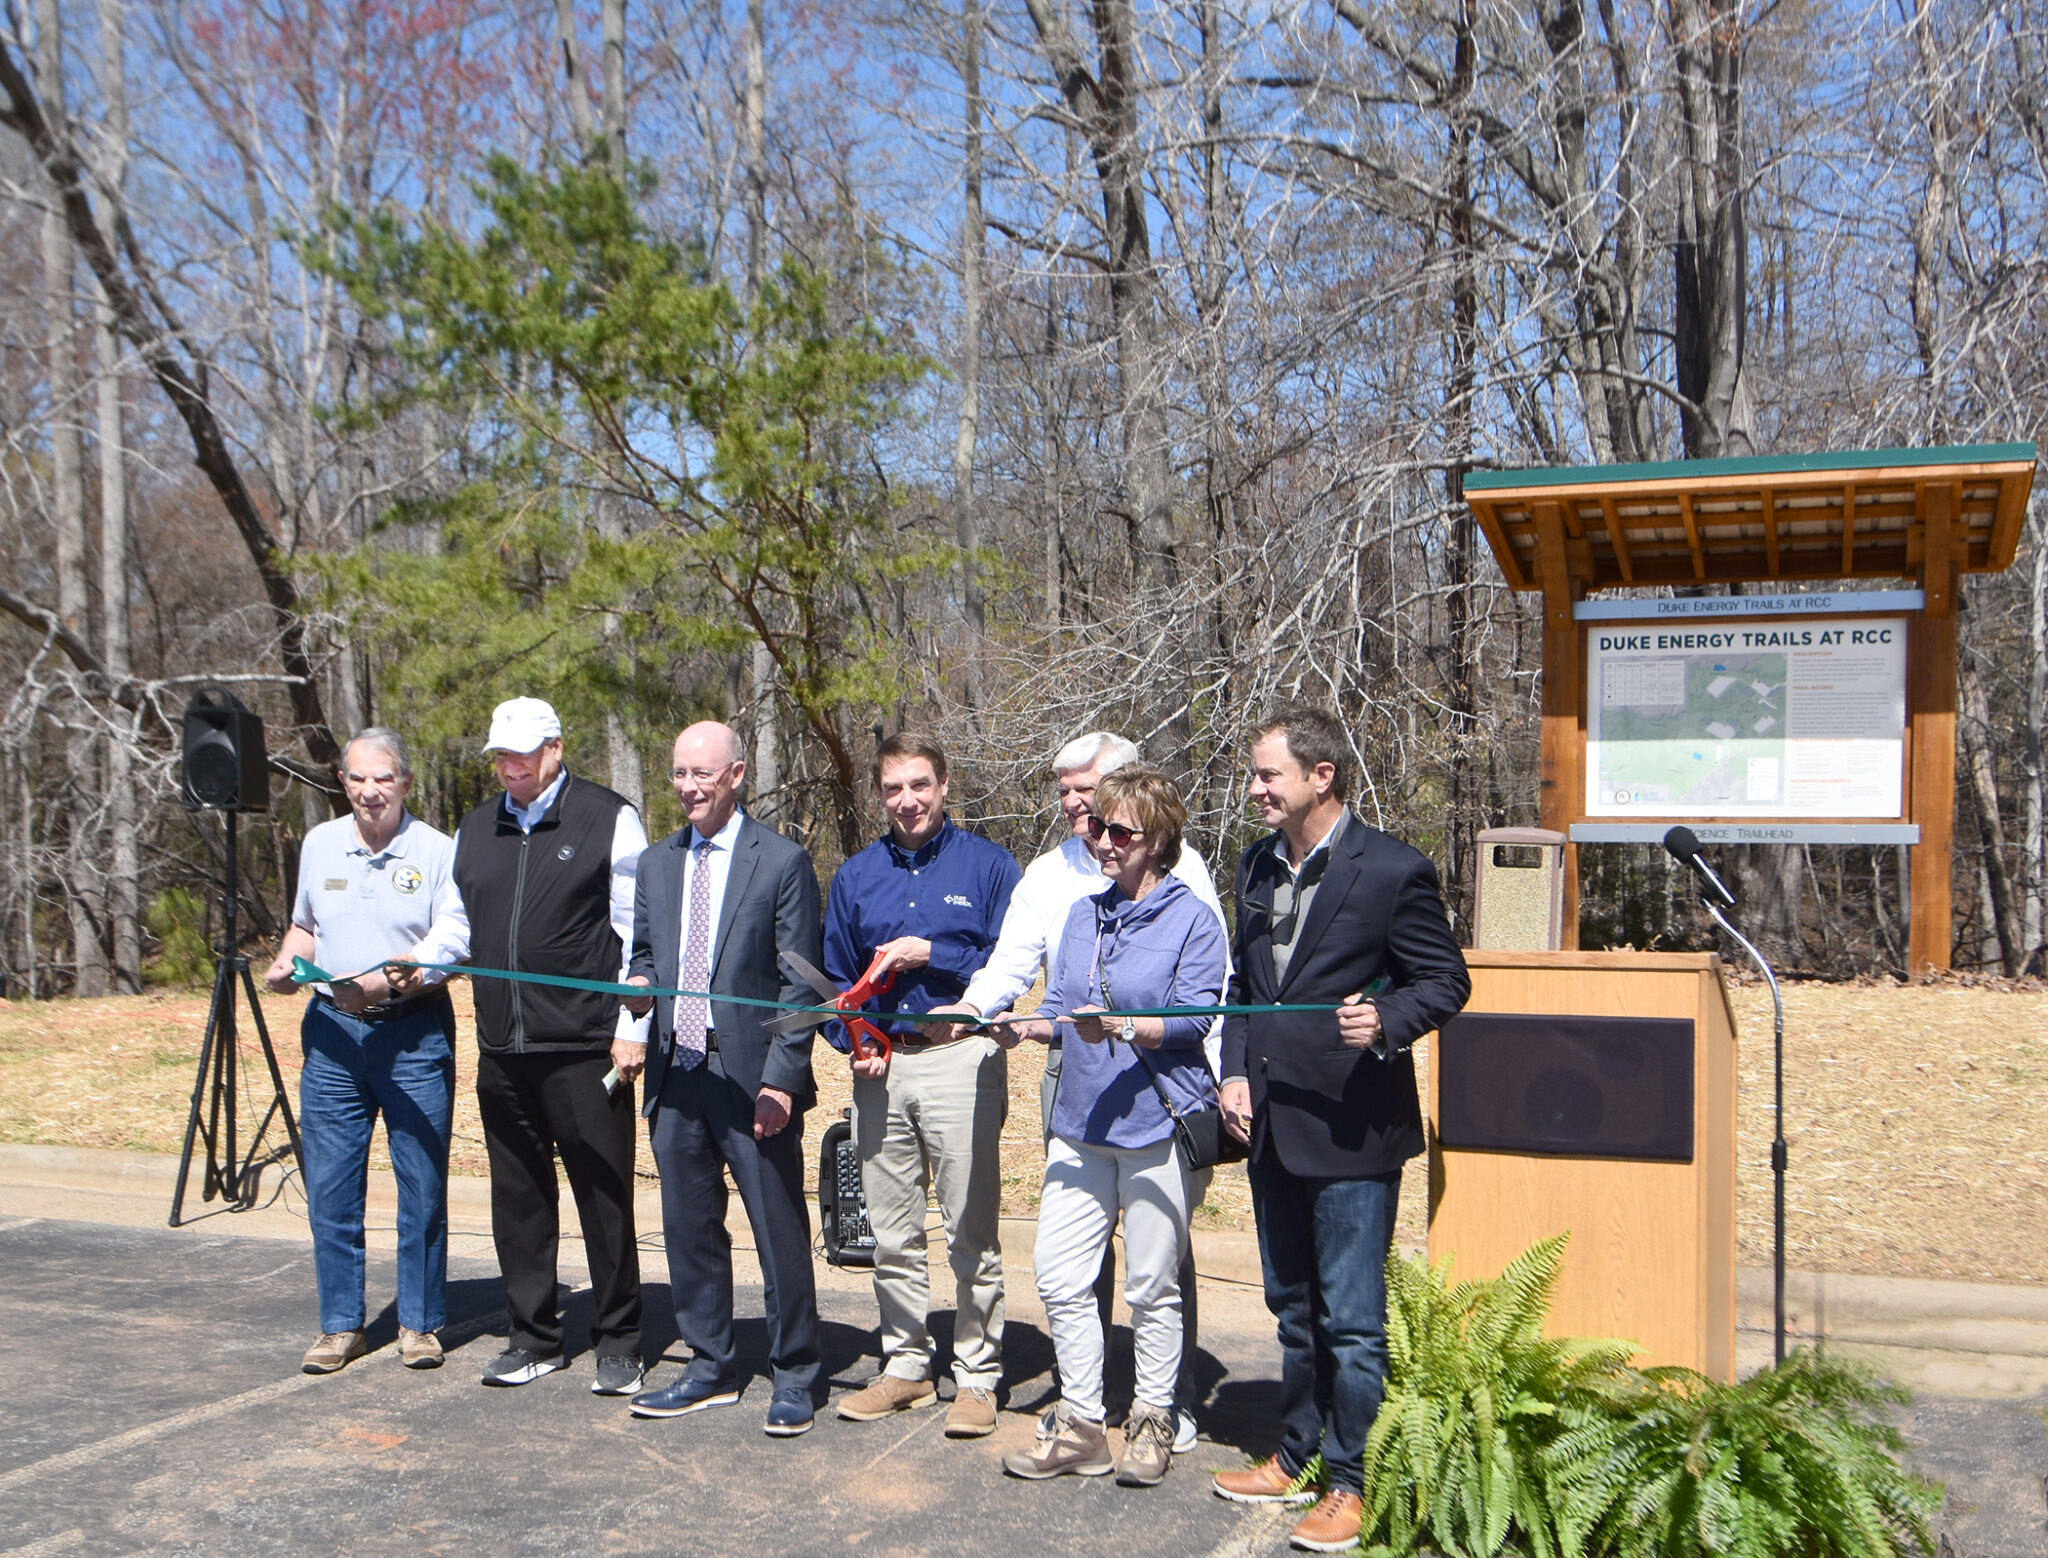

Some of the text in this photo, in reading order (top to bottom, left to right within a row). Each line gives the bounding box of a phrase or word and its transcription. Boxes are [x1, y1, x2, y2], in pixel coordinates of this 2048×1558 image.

[1658, 597, 1831, 613] DUKE ENERGY TRAILS AT RCC
[1600, 629, 1892, 651] DUKE ENERGY TRAILS AT RCC
[1737, 828, 1793, 839] TRAILHEAD
